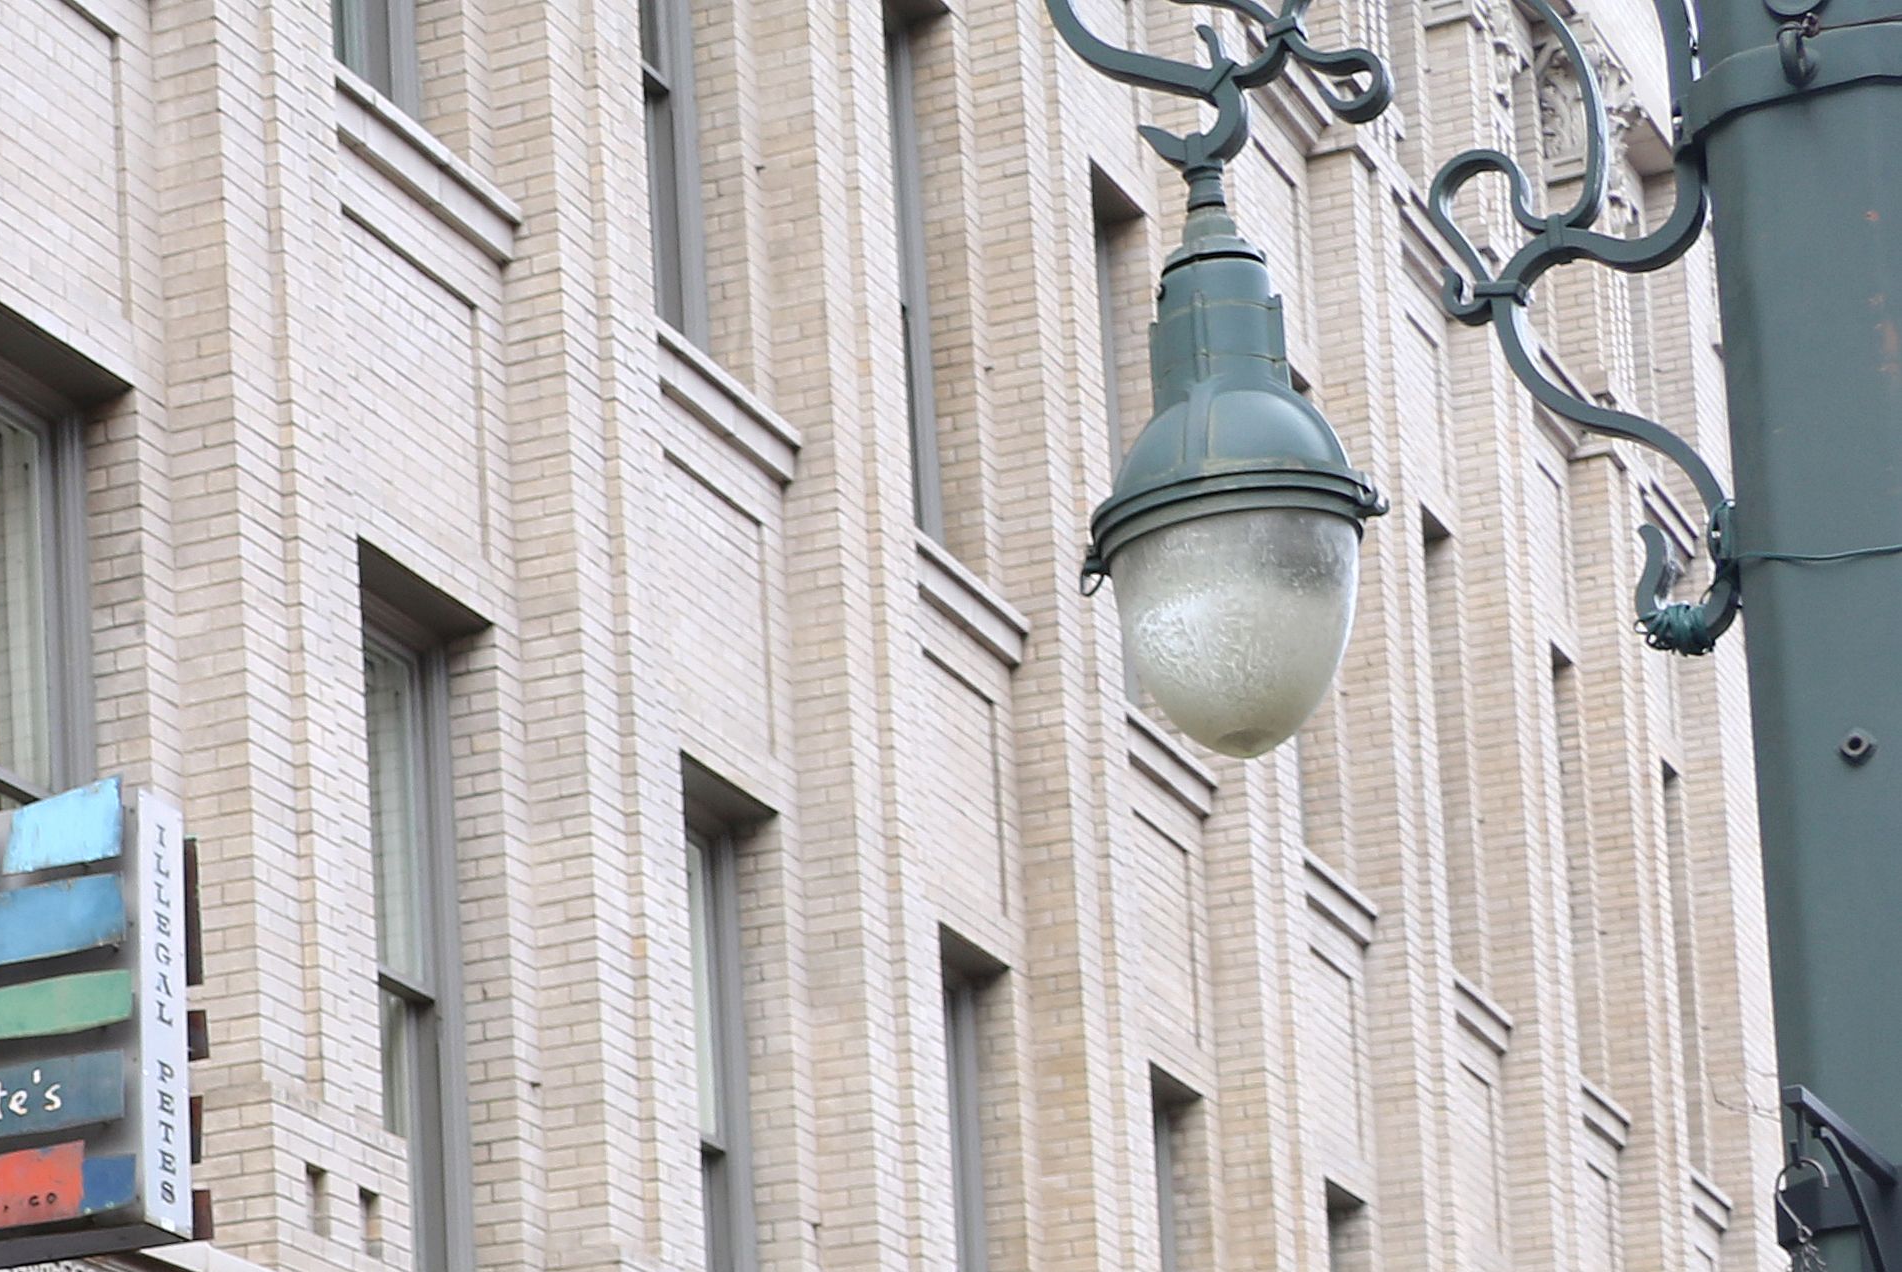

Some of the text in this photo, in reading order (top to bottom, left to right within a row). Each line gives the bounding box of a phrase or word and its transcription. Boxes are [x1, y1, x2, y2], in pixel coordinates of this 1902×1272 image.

[153, 823, 176, 1205] ILLEGAL PETES
[27, 1190, 59, 1208] co
